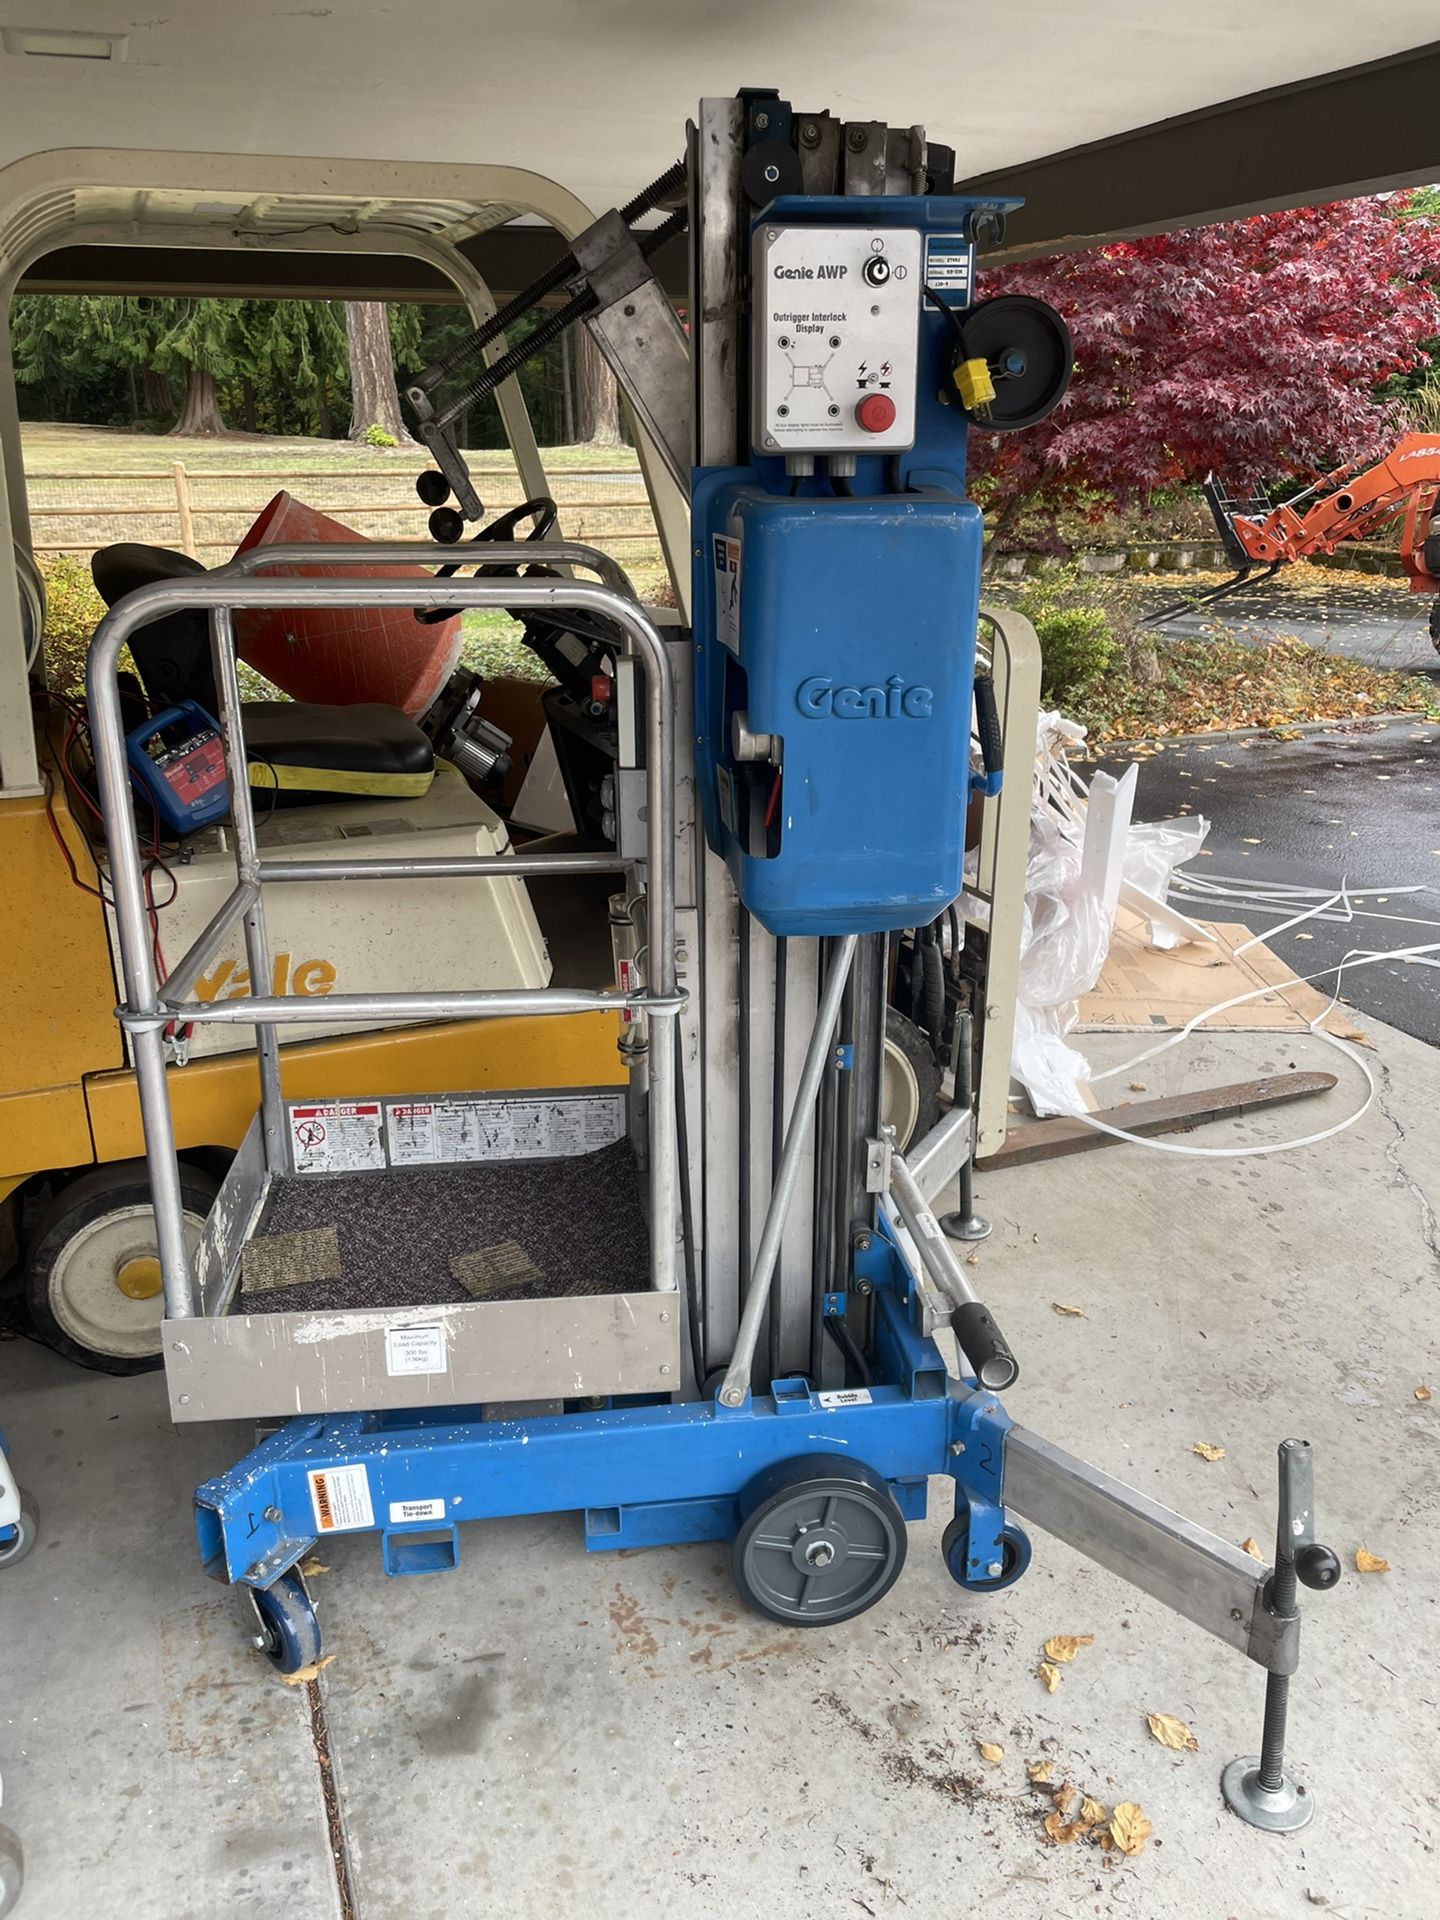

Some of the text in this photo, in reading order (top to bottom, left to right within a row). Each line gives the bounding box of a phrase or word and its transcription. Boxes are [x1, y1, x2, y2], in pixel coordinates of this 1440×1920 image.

[773, 265, 848, 279] Genie AWP
[773, 312, 847, 323] Outrigger Interlock
[795, 323, 825, 334] Display
[797, 674, 934, 719] Genie
[322, 1107, 358, 1116] DAGER
[411, 1340, 437, 1348] Capacity
[979, 1442, 996, 1476] 2
[315, 1478, 331, 1518] WARNING
[402, 1503, 433, 1511] Transport
